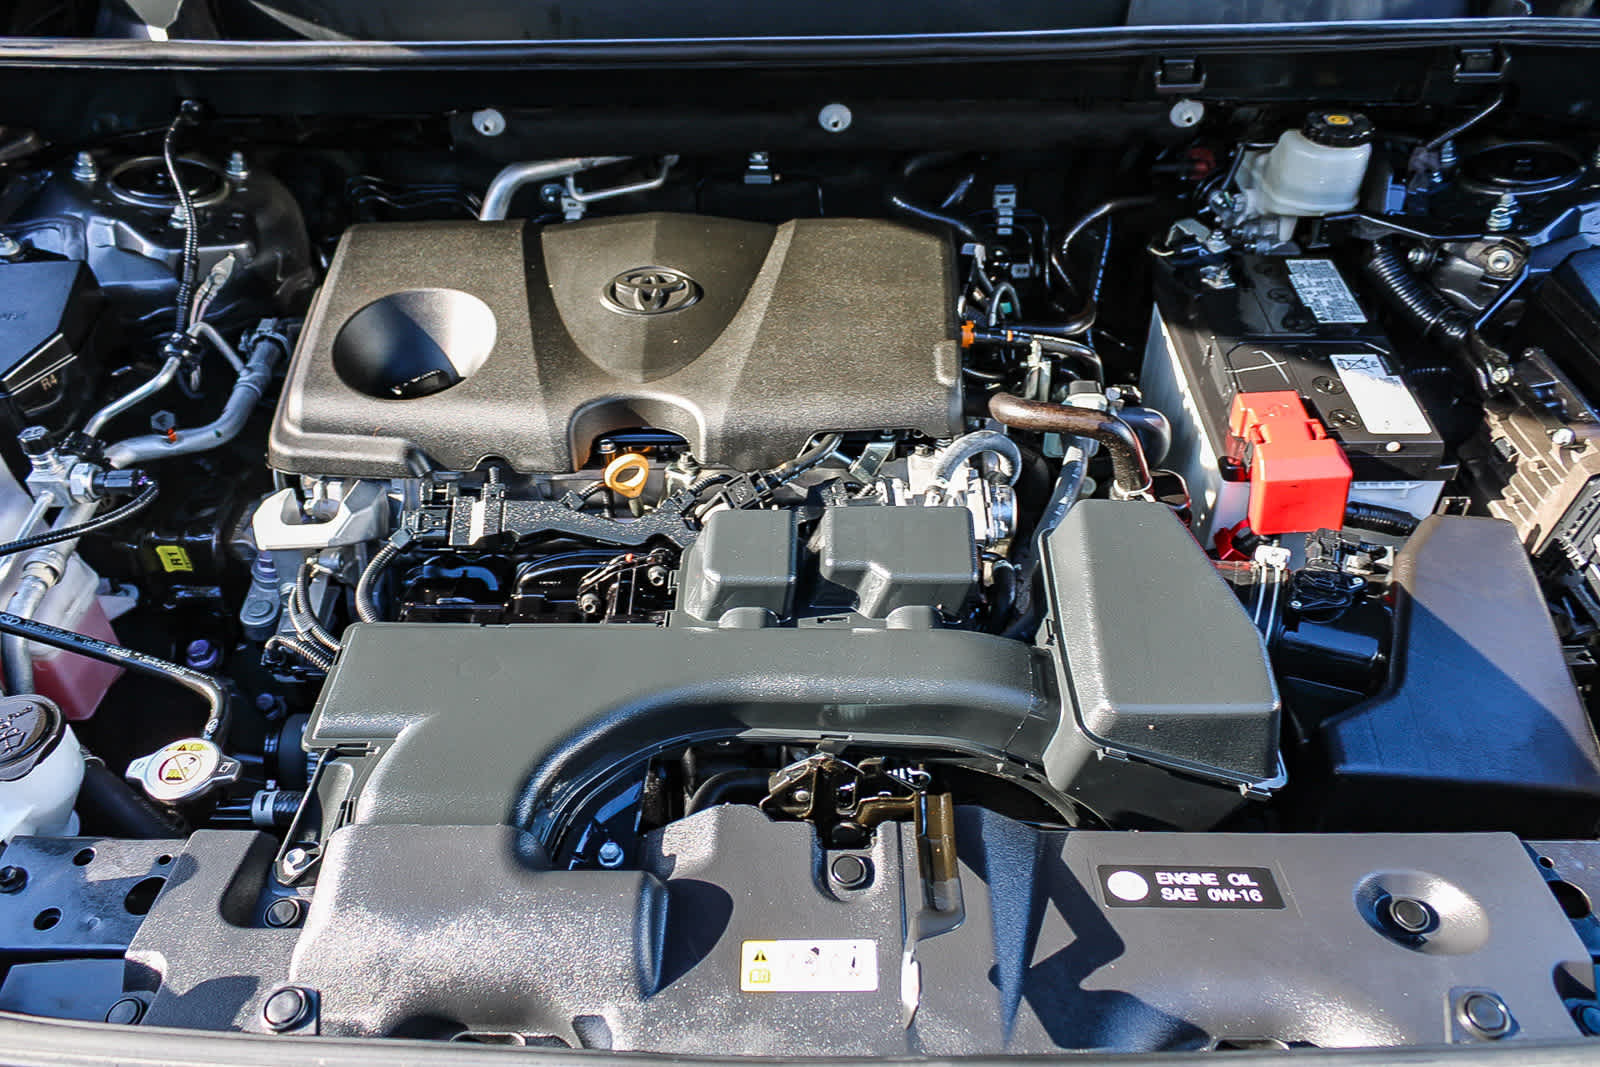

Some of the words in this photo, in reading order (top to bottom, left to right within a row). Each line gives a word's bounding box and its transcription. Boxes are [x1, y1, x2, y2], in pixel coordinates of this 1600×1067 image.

[41, 374, 57, 391] R4
[1155, 872, 1220, 886] ENGINE
[1227, 873, 1258, 886] OIL
[1160, 887, 1199, 901] SAE
[1207, 888, 1264, 902] 0W-16
